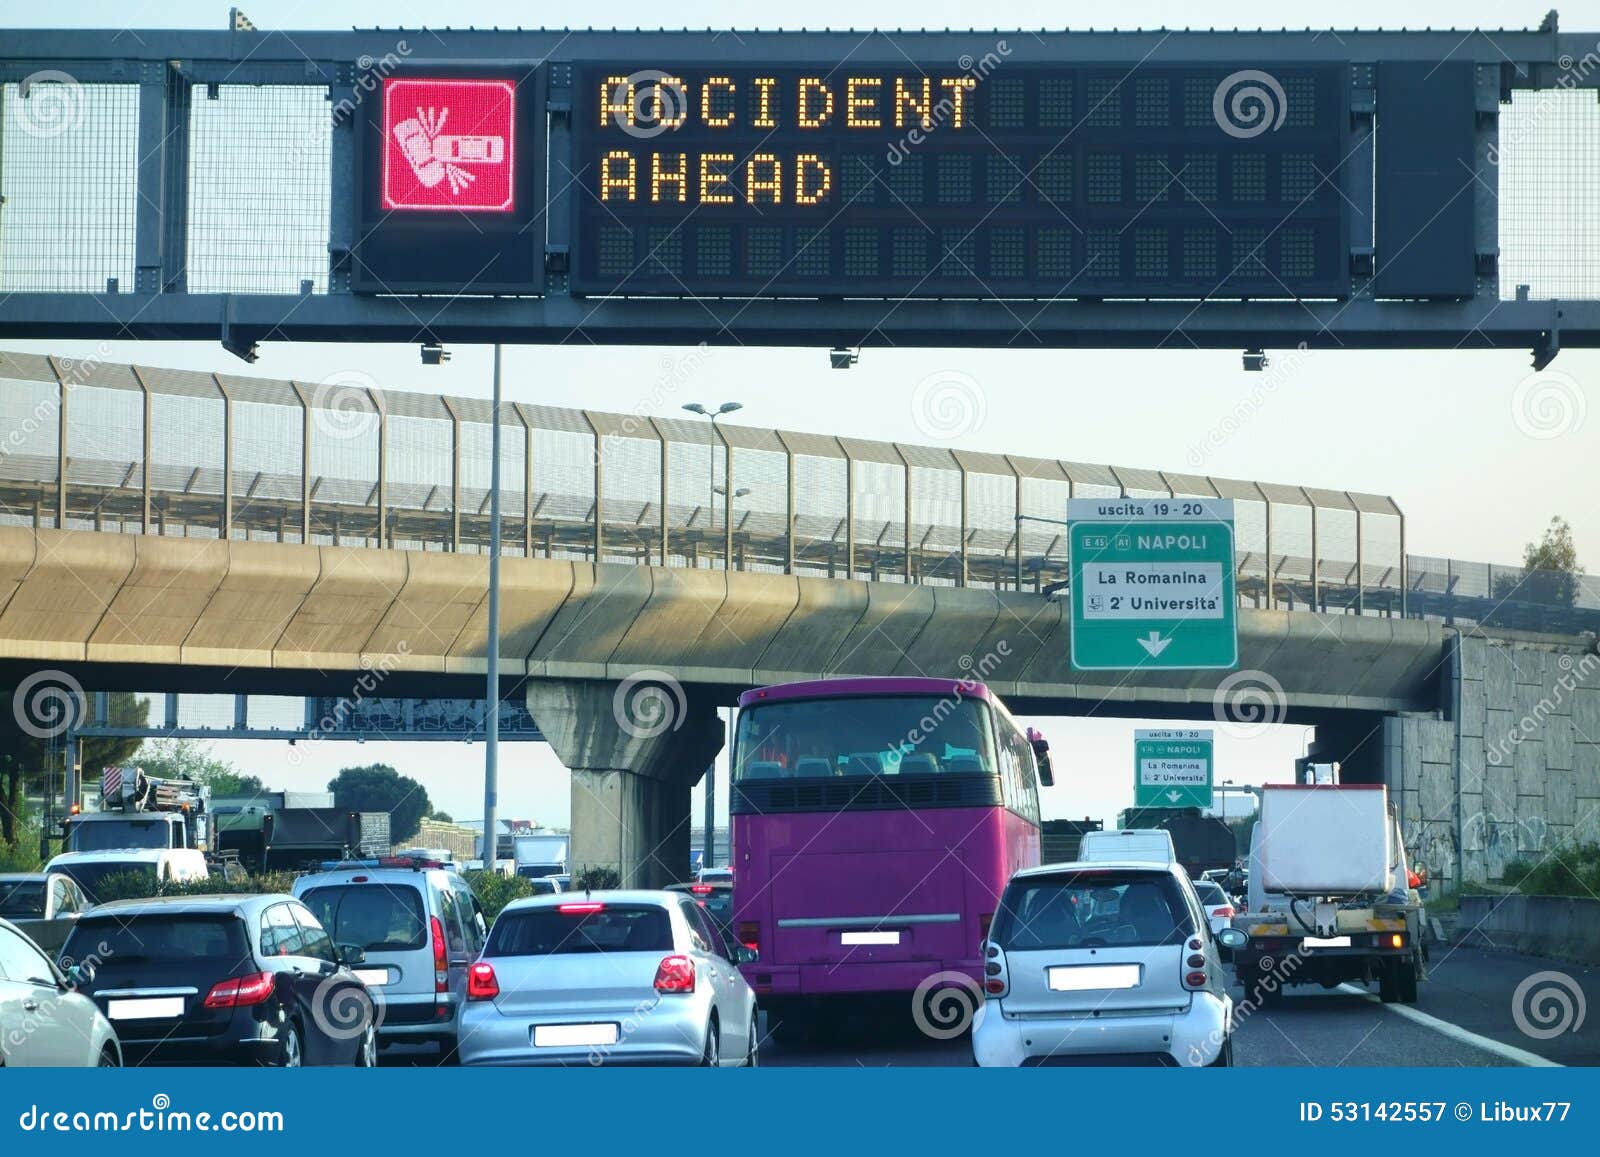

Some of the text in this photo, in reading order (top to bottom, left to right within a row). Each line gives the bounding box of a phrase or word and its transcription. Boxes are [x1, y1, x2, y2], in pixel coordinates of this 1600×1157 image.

[600, 76, 976, 128] ACCIDENT
[601, 151, 831, 203] AHEAD
[1098, 503, 1144, 516] uscita
[1154, 503, 1169, 516] 19
[1183, 503, 1203, 516] 20
[1084, 537, 1091, 547] E
[1137, 535, 1207, 550] NAPOLI
[1098, 571, 1207, 585] La Romanina
[1167, 745, 1200, 753] NAPOLI
